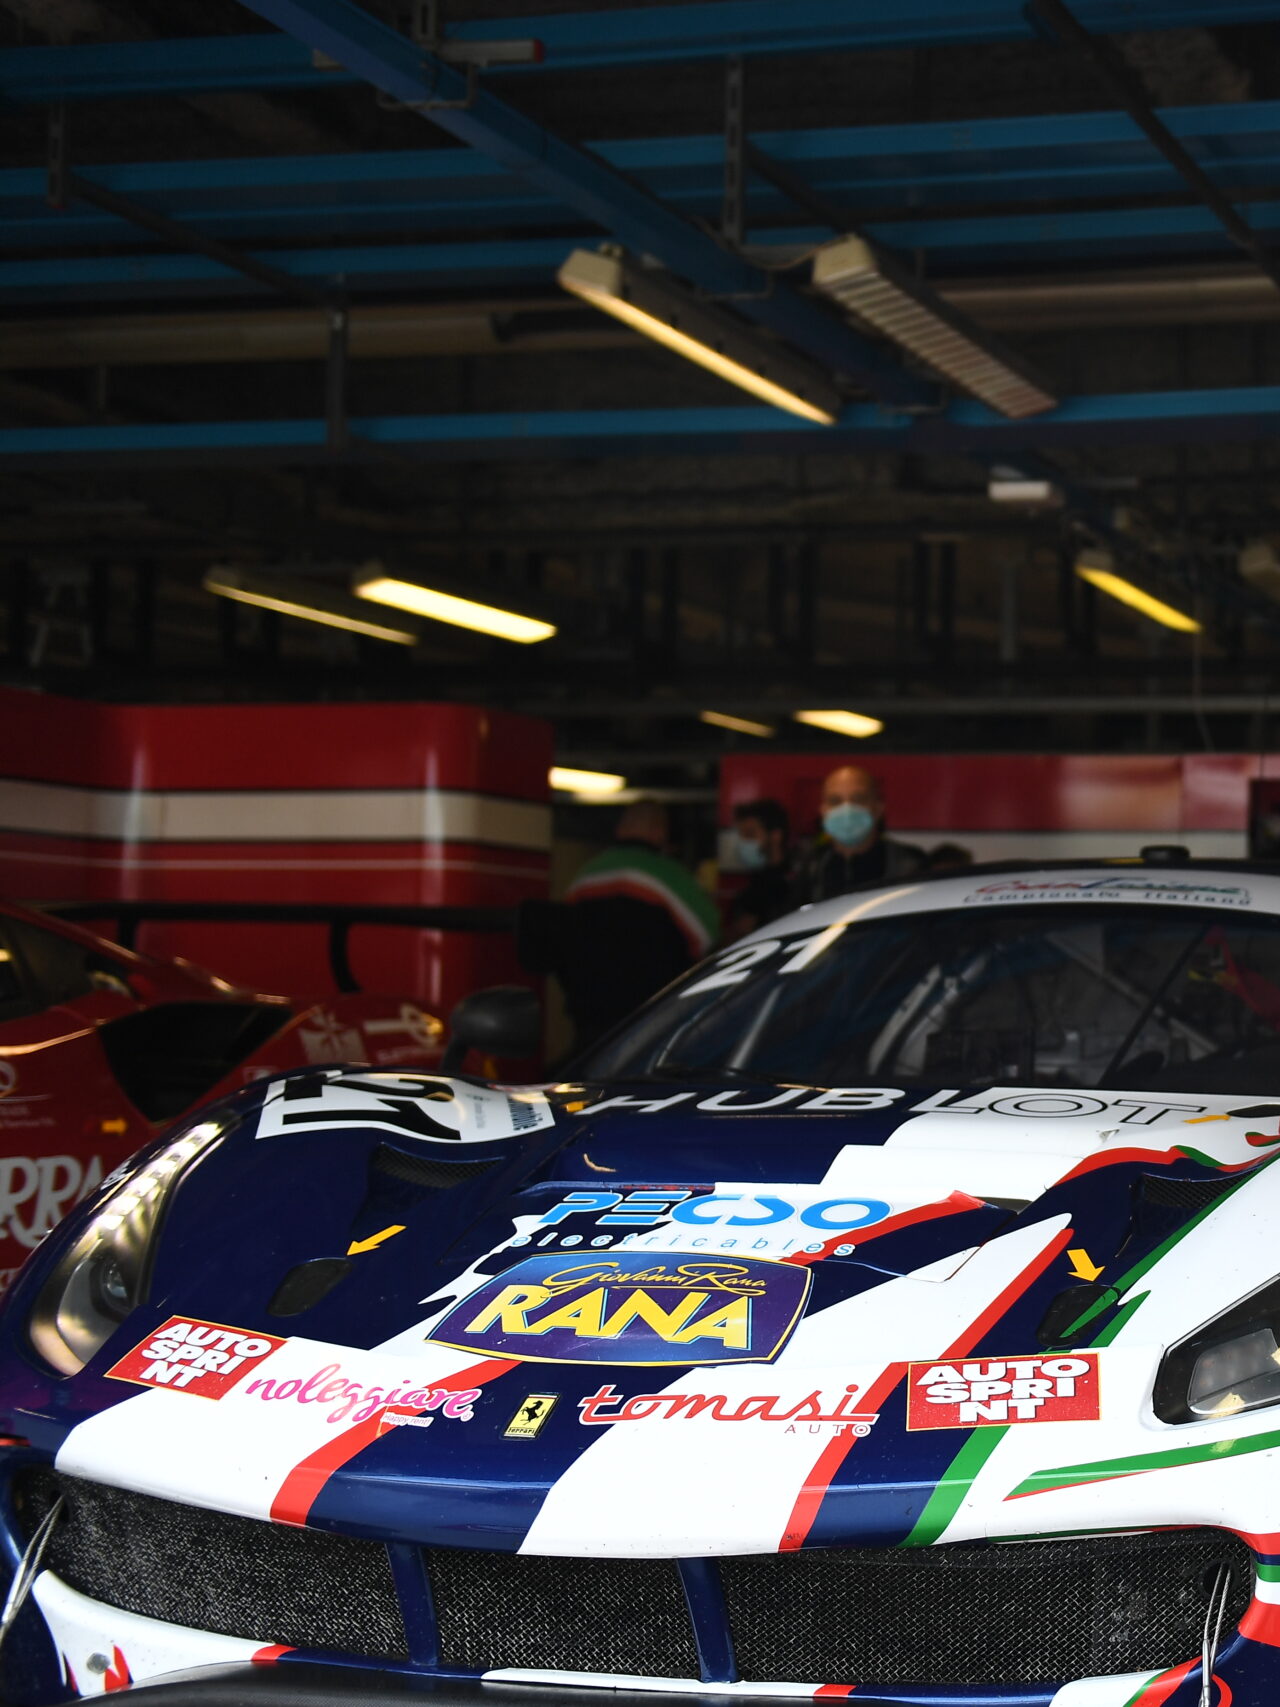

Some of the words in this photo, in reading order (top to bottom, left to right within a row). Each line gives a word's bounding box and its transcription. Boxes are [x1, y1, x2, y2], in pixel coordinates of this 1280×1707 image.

[679, 924, 850, 998] 21
[579, 1086, 1207, 1125] HUBLOT
[511, 1232, 856, 1257] electricables
[677, 1262, 767, 1289] Rana
[464, 1284, 753, 1350] RANA
[140, 1339, 248, 1375] SPRI
[152, 1322, 272, 1359] AUTO
[139, 1359, 210, 1389] NT
[916, 1357, 1092, 1385] AUTO
[245, 1363, 482, 1424] noleggiare
[579, 1383, 879, 1426] tomasi
[925, 1377, 1077, 1401] SPRI
[957, 1396, 1046, 1424] NT
[784, 1422, 871, 1438] AUTO
